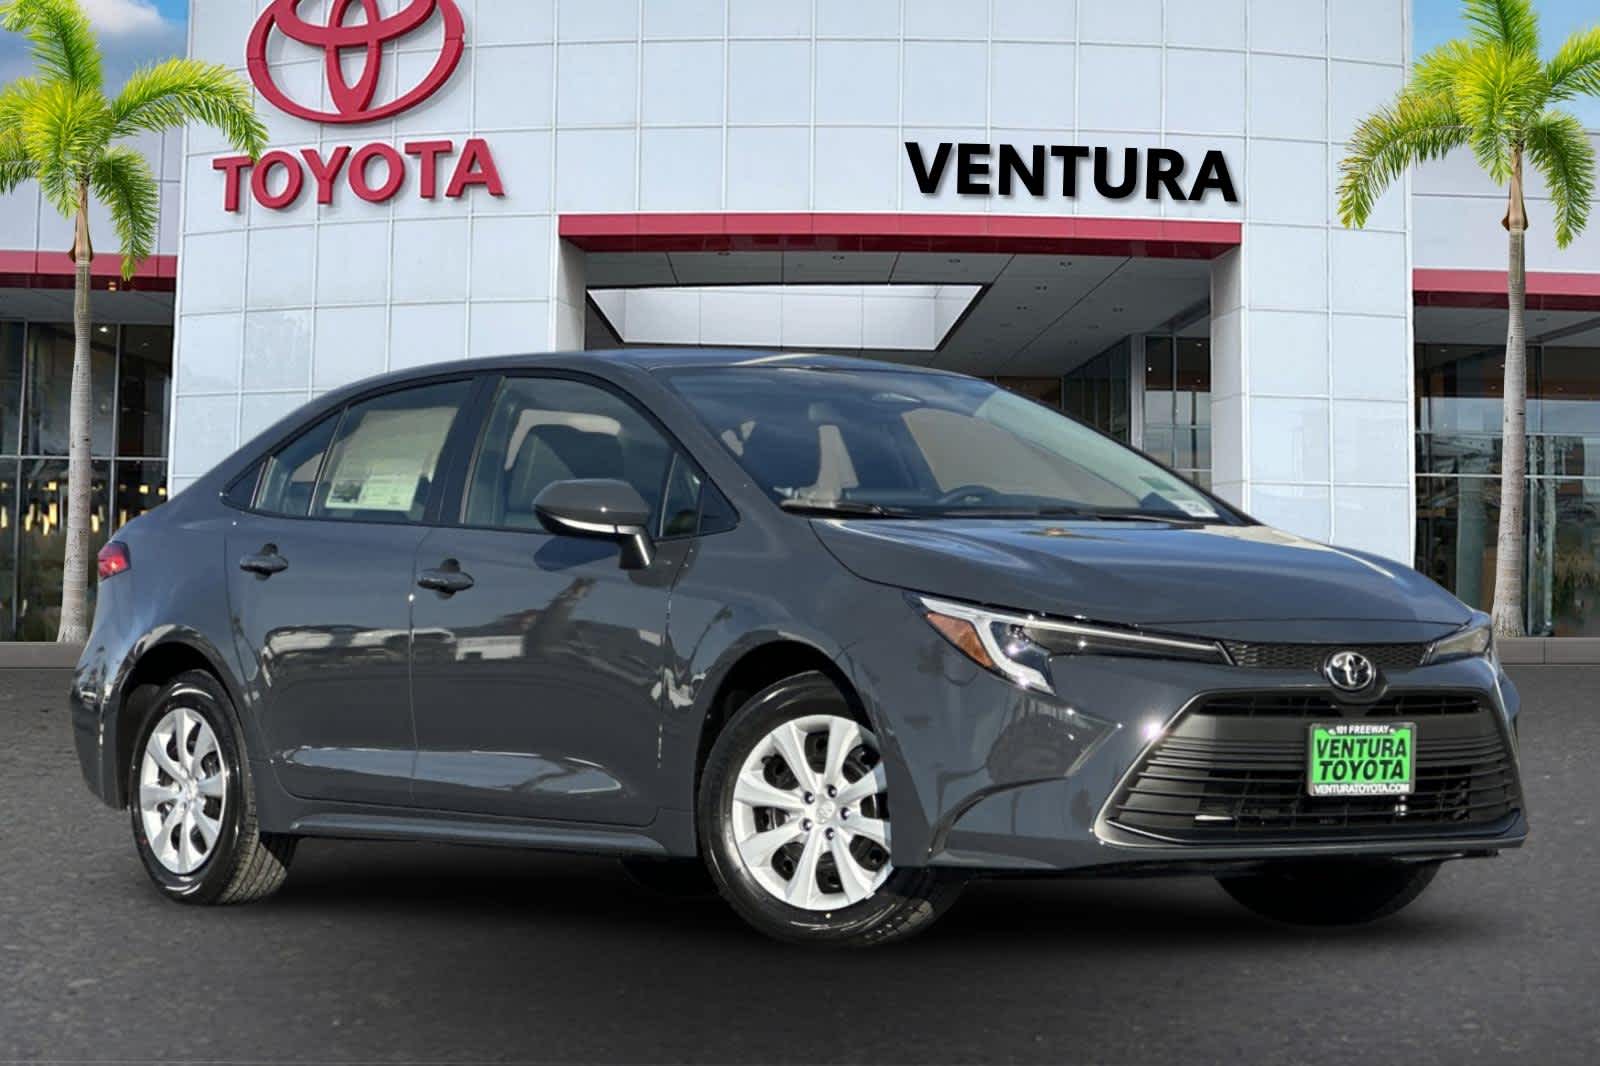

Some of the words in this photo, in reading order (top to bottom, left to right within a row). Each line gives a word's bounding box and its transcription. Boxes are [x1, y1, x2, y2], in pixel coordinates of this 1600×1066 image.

[213, 138, 505, 211] TOYOTA
[905, 141, 1238, 202] VENTURA
[1349, 725, 1390, 734] FREEWAY
[1316, 738, 1407, 758] VENTURA
[1319, 760, 1404, 780] TOYOTA
[1314, 783, 1410, 794] VENTURATOYOTA.COM
